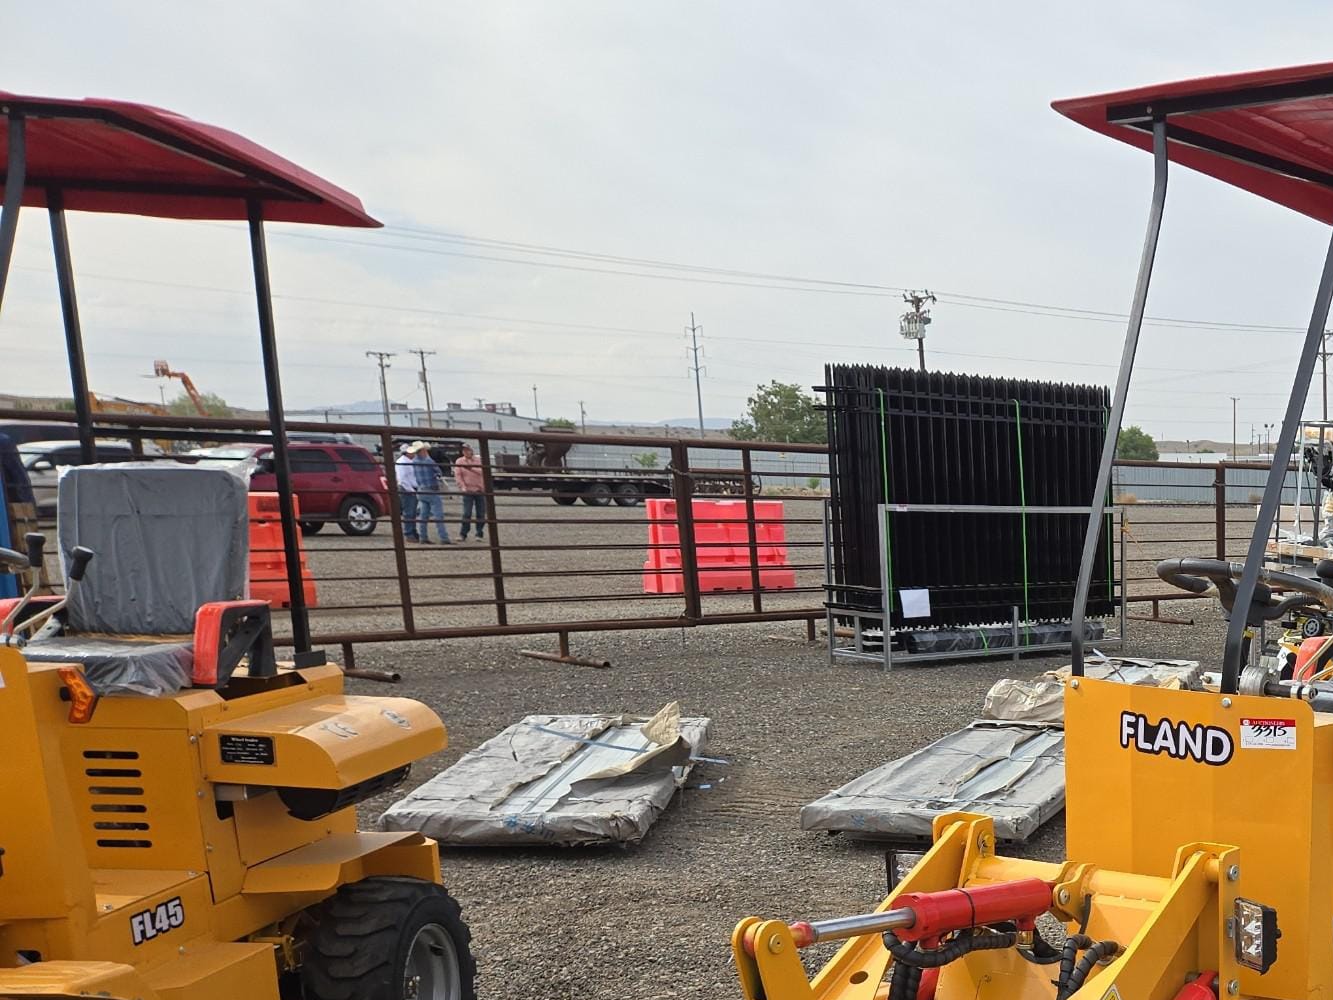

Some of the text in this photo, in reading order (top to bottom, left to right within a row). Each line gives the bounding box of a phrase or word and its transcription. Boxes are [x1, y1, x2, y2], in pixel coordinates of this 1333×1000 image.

[1120, 712, 1233, 765] FLAND
[1251, 724, 1288, 738] 3315
[131, 896, 184, 945] FL45
